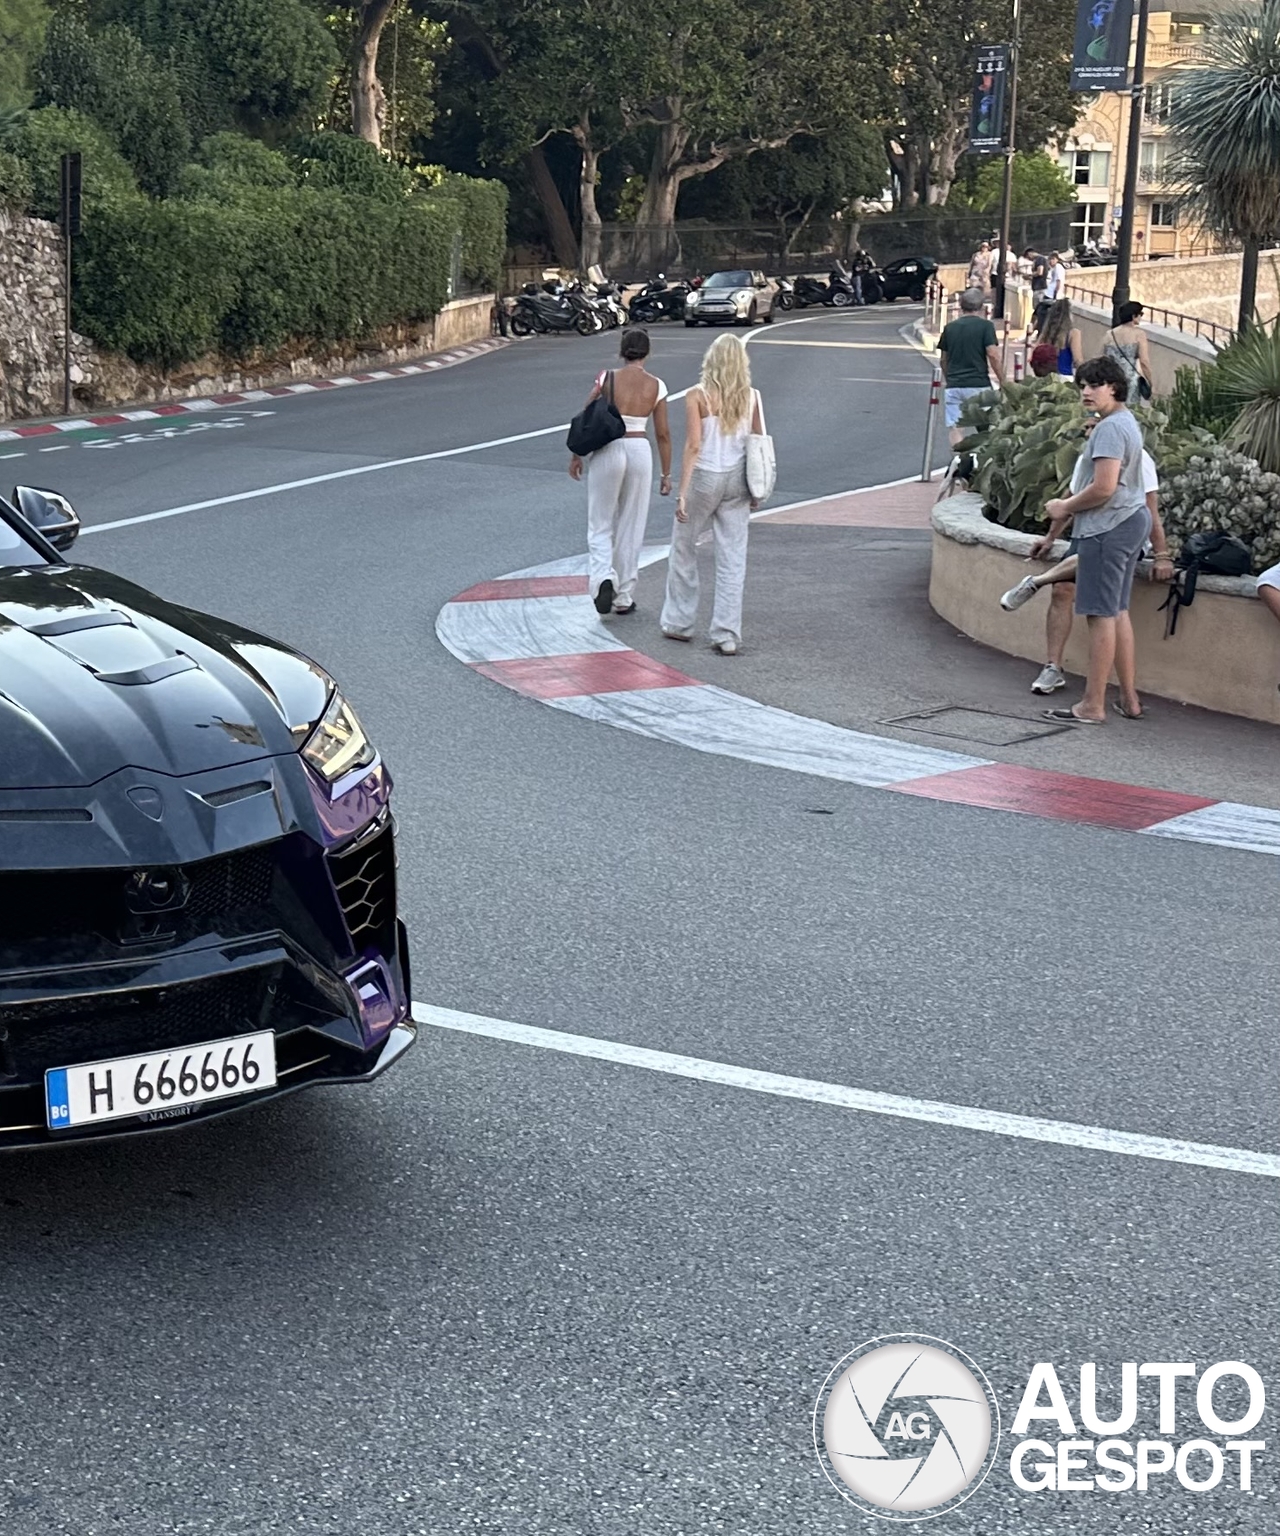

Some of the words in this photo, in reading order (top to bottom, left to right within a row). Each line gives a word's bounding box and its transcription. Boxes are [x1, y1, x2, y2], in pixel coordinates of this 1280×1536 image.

[51, 1105, 68, 1119] BG
[88, 1069, 114, 1115] H
[133, 1043, 260, 1105] 666666
[148, 1104, 192, 1122] MANSORY
